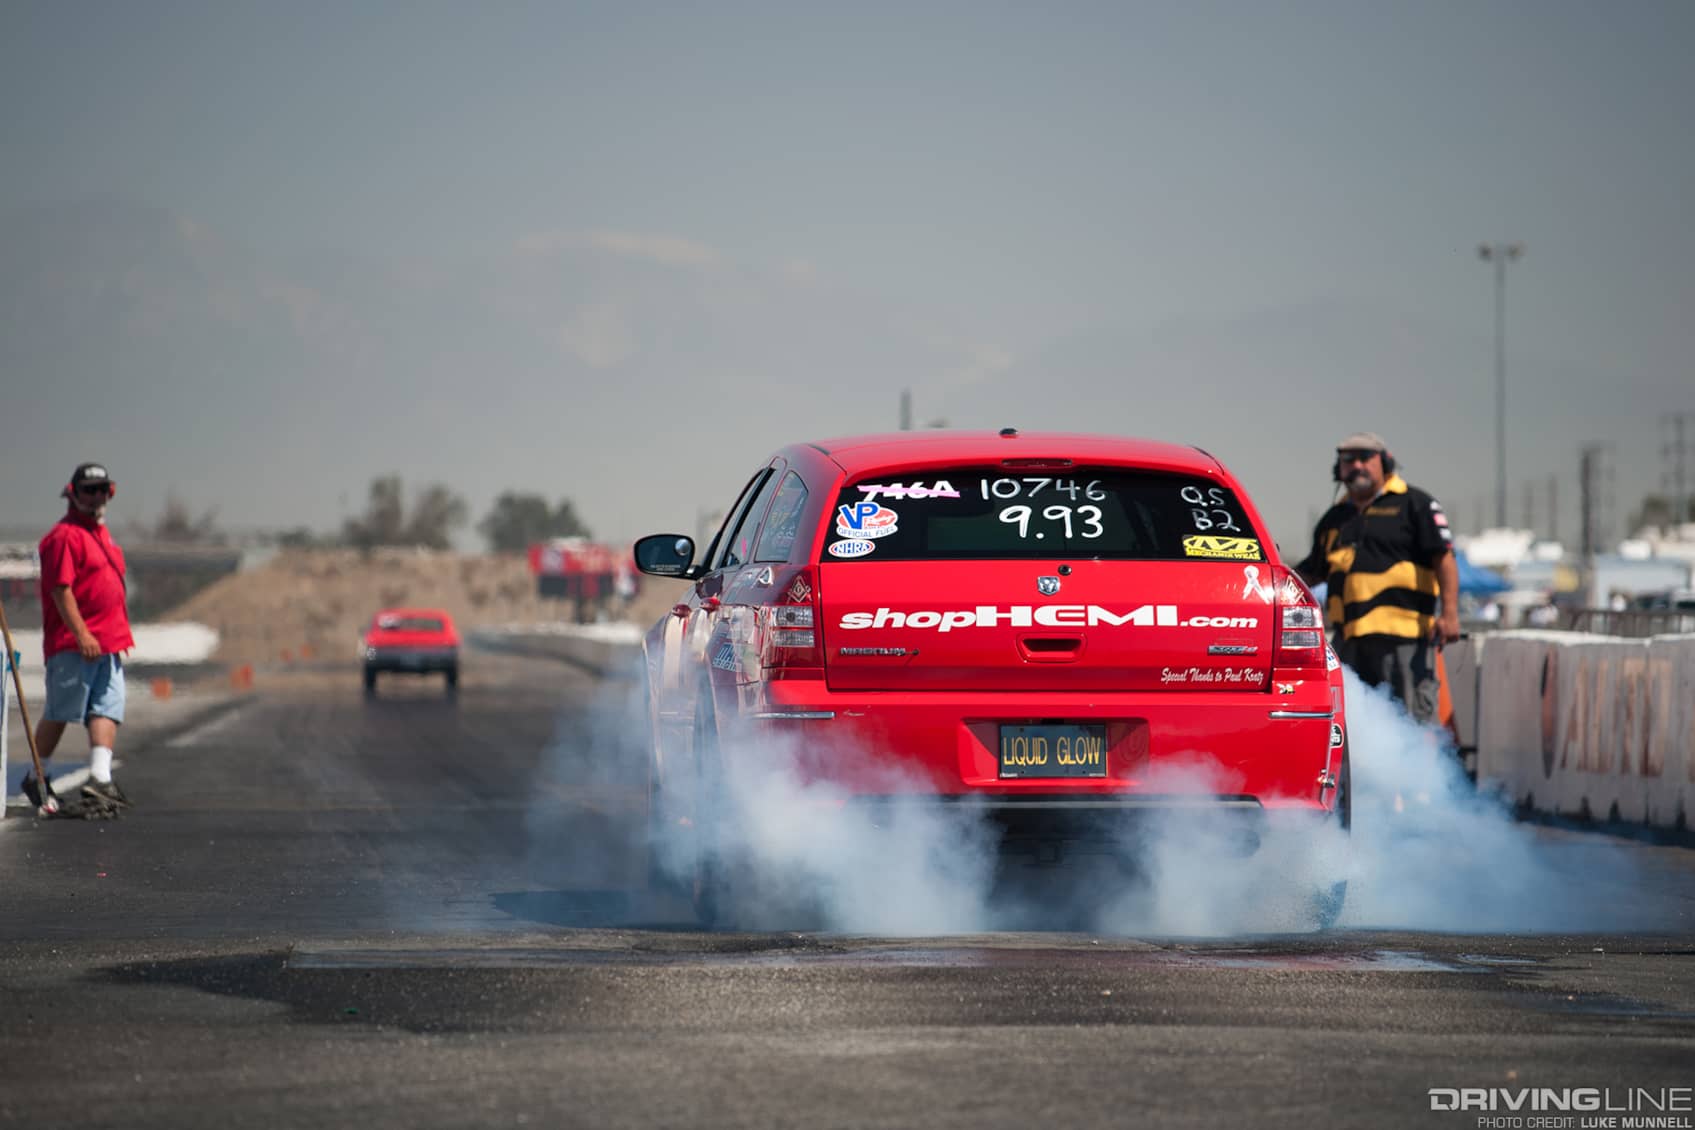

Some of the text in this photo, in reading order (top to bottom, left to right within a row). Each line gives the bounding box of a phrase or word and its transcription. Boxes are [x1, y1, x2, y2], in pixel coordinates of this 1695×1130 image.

[980, 478, 1106, 501] 10746
[841, 502, 879, 530] VP
[999, 505, 1103, 538] 9.93
[1191, 508, 1241, 532] B2
[838, 527, 872, 538] OFFICIAL
[835, 542, 870, 554] NHRA
[839, 605, 1258, 632] shopHEMI.com
[1161, 667, 1188, 685] Special
[1189, 667, 1214, 682] Thanks
[1215, 671, 1223, 682] to
[1223, 667, 1243, 682] Paul
[1003, 736, 1101, 766] LIQUID GLOW
